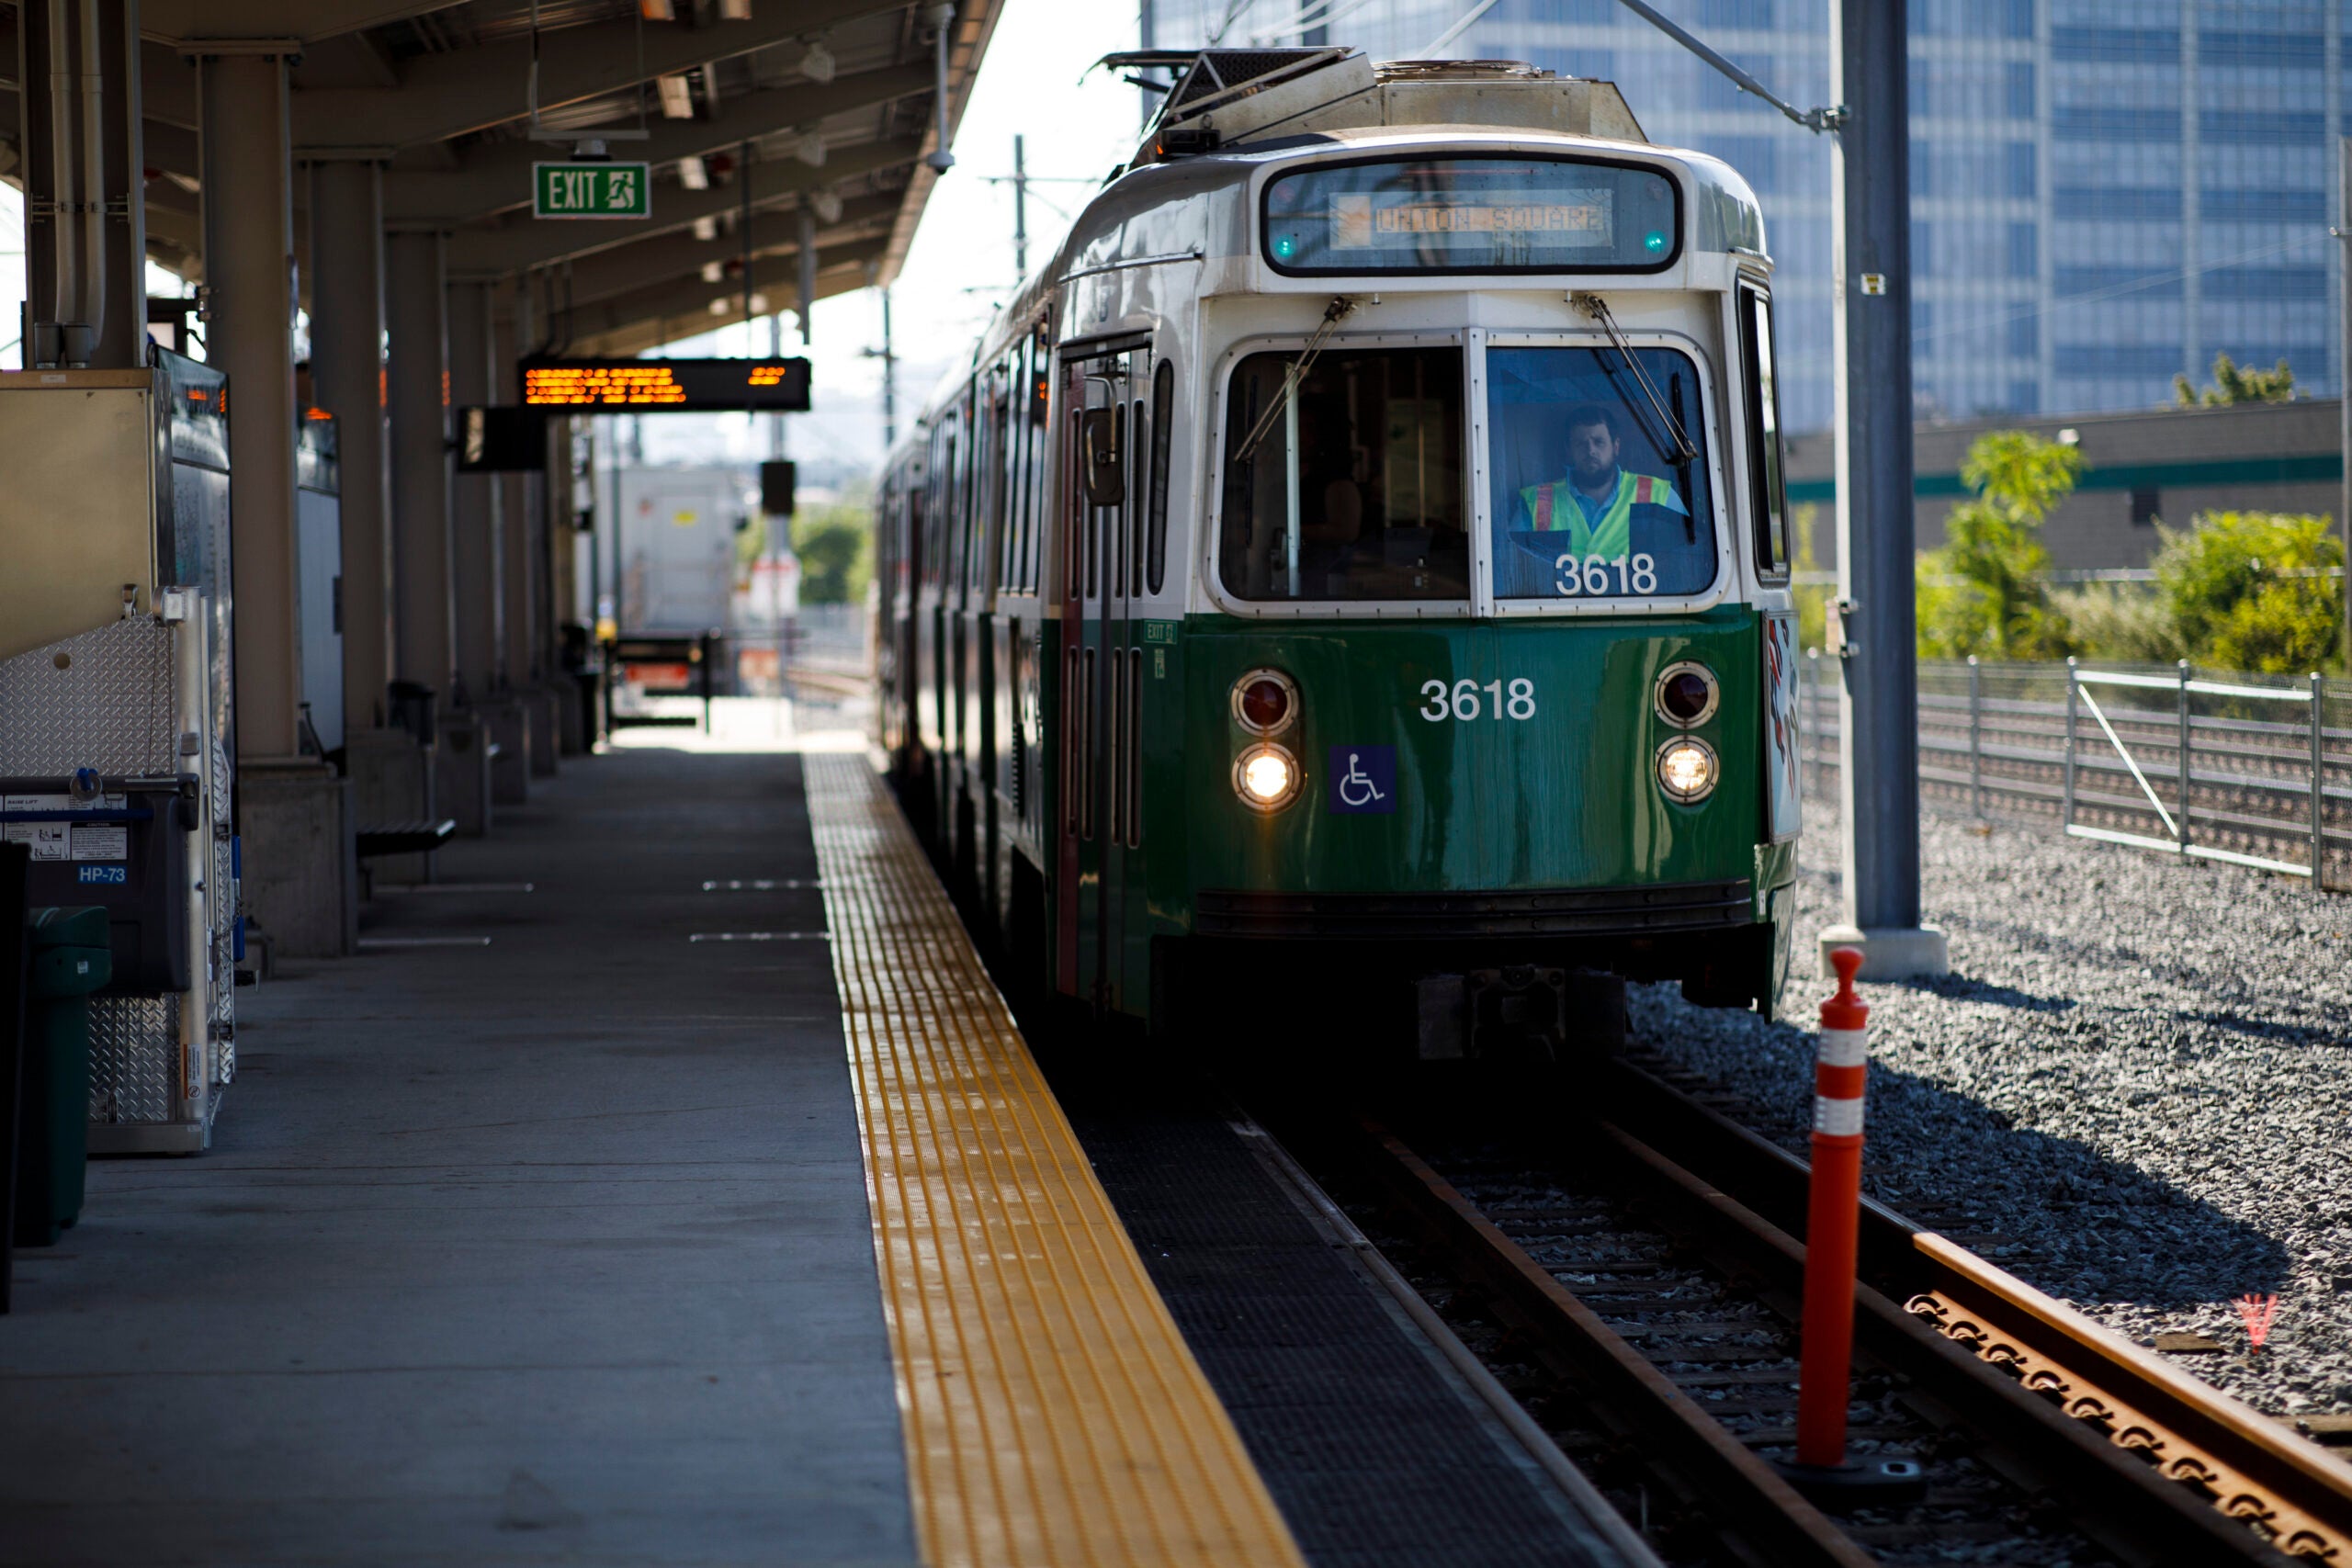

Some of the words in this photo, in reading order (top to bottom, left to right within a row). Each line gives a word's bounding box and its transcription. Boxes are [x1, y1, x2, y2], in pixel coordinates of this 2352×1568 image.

[548, 171, 598, 209] EXIT
[1377, 208, 1470, 232] UNION
[1492, 206, 1600, 231] SQUARE
[1555, 553, 1657, 595] 3618
[1148, 624, 1164, 639] EXIT
[1419, 678, 1536, 721] 3618
[80, 867, 125, 882] HP-73
